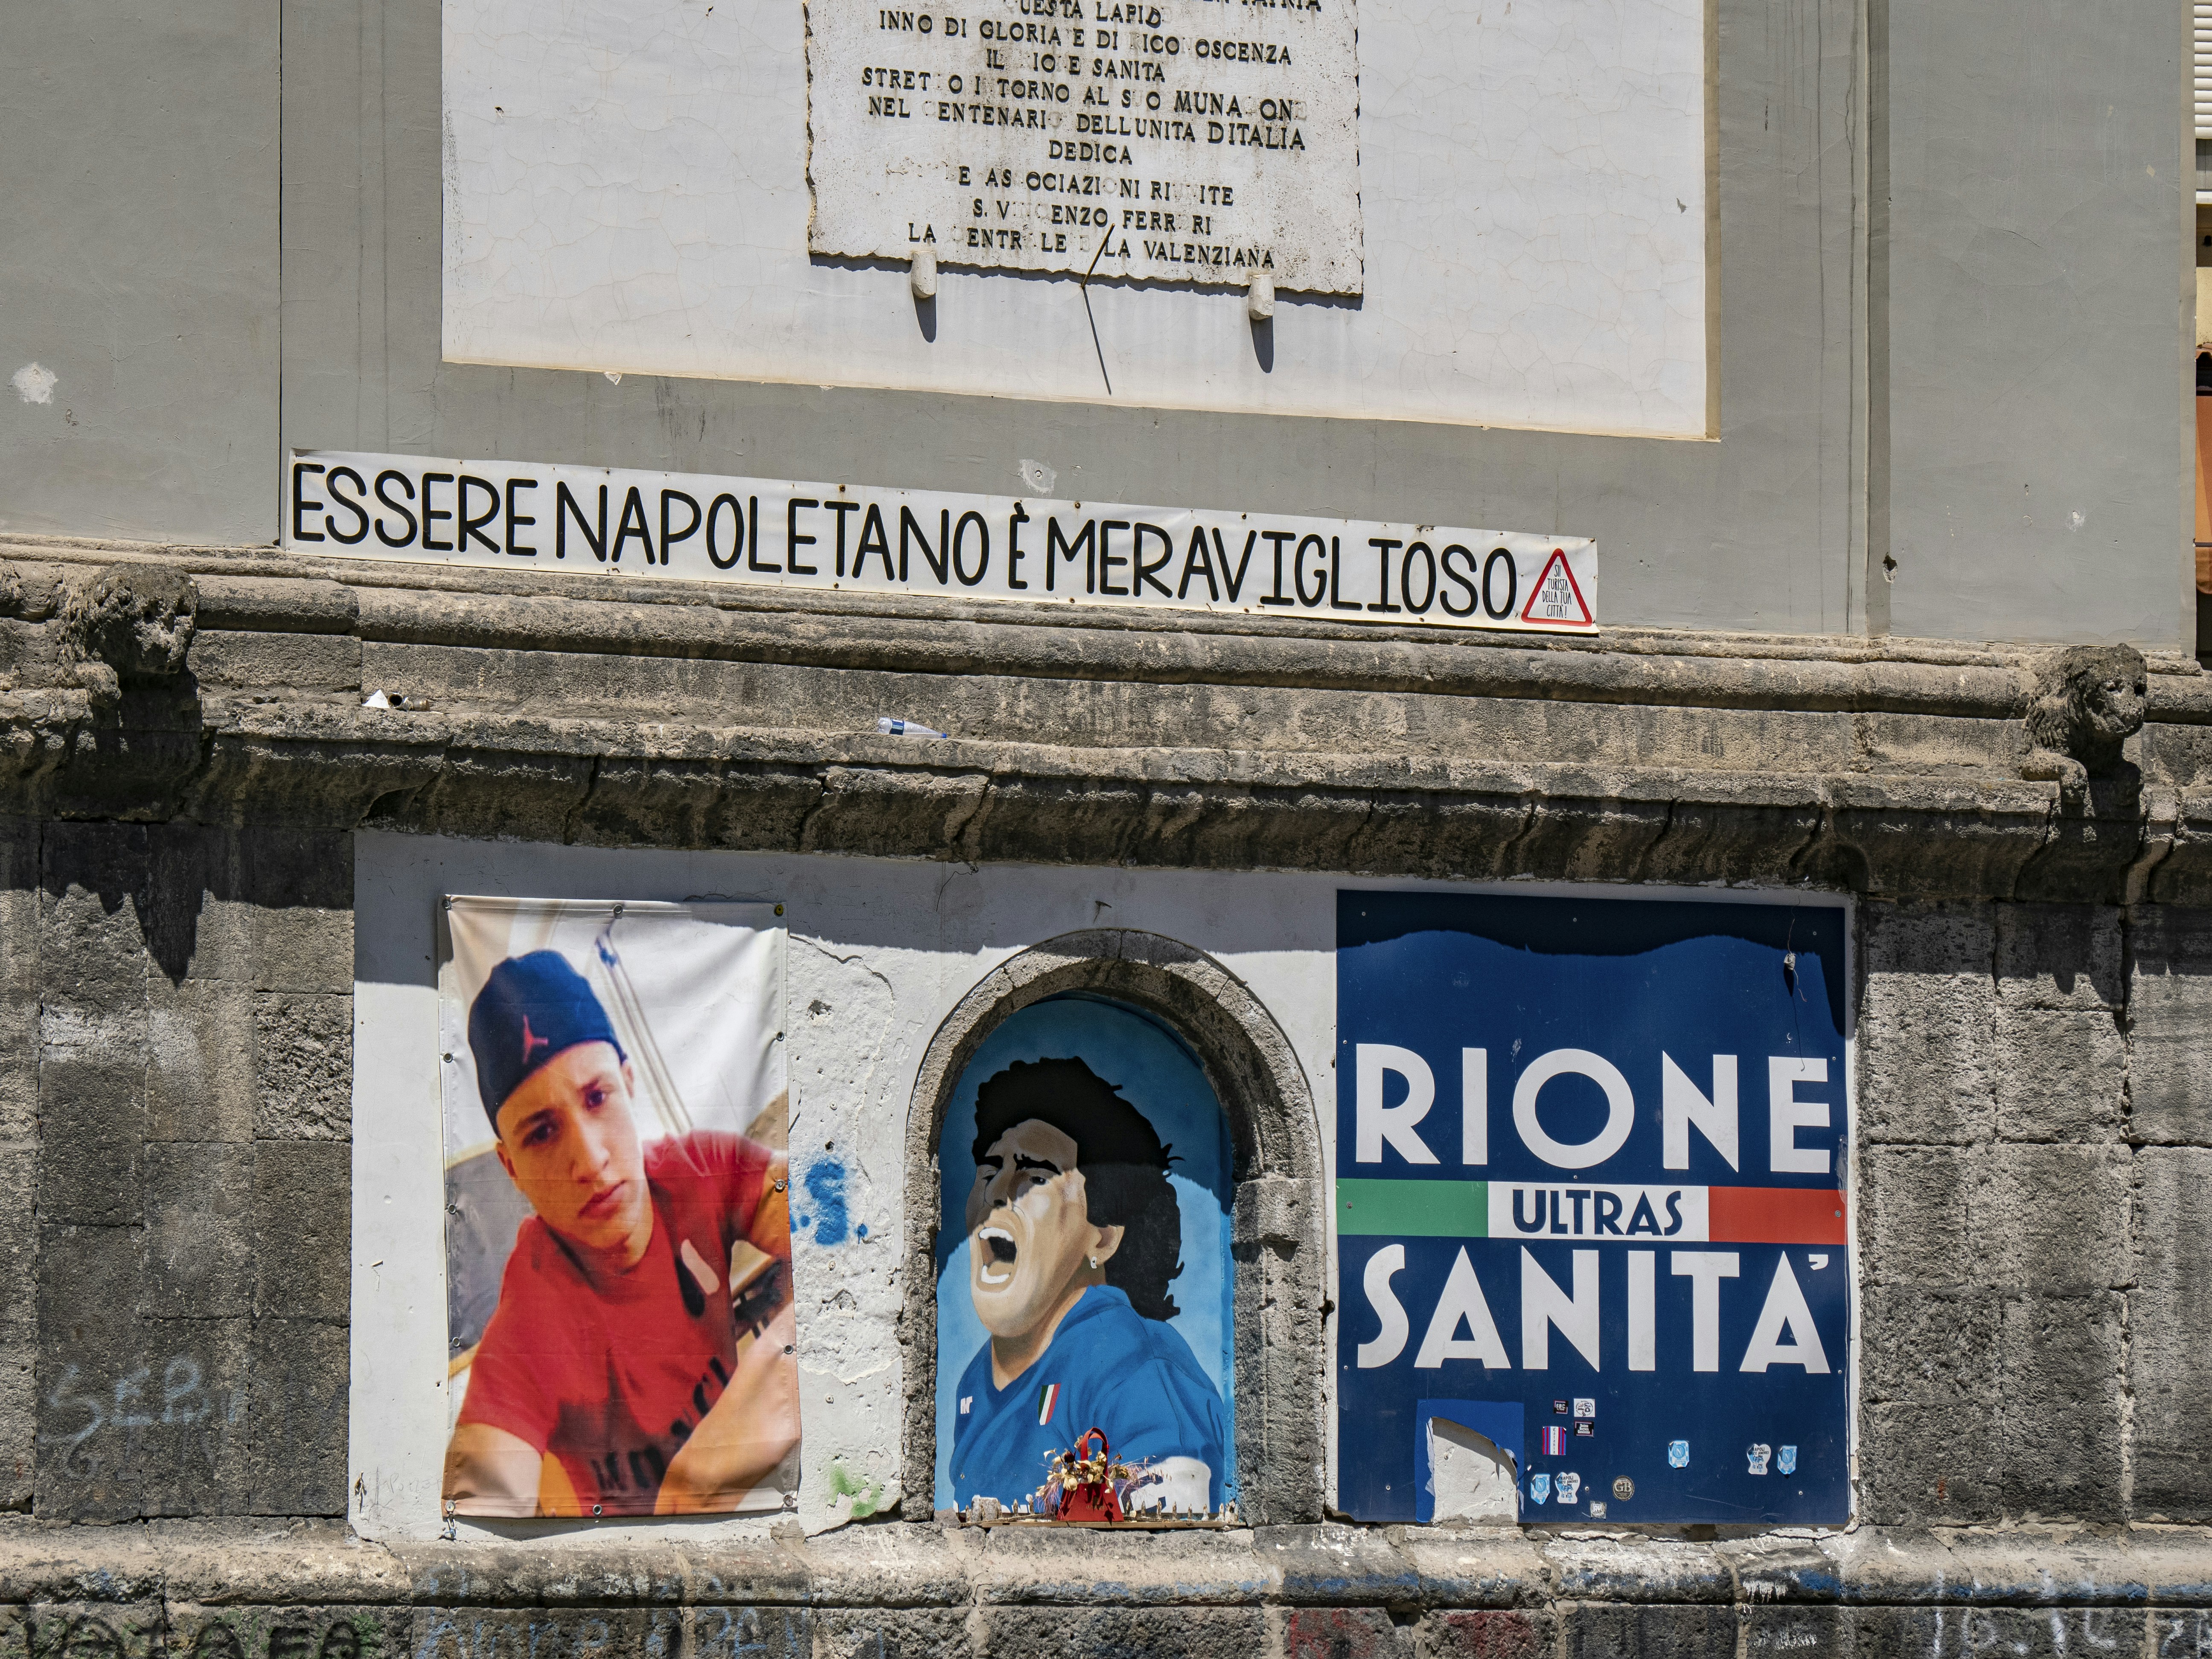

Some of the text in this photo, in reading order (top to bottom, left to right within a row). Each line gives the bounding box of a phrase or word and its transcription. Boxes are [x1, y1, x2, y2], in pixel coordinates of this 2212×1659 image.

[880, 9, 933, 34] INNO
[945, 17, 966, 38] DI
[979, 19, 1062, 46] GLORIA
[1073, 27, 1085, 47] E
[1096, 29, 1118, 50] DI
[986, 48, 1005, 70] IL
[1092, 57, 1165, 83] SANITA
[868, 96, 911, 119] NEL
[1083, 85, 1110, 106] AL
[1049, 140, 1132, 165] DEDICA
[908, 222, 936, 243] LA
[1103, 236, 1131, 259] LA
[1144, 240, 1275, 269] VALENZIANA
[293, 463, 1517, 621] ESSERE NAPOLETANO È MERAVIGLIOSO
[1542, 591, 1572, 605] DELLA TUA
[1547, 578, 1569, 591] TURISTA
[1356, 1043, 1831, 1173] RIONE
[1513, 1189, 1682, 1236] ULTRAS
[1615, 1482, 1632, 1492] GB
